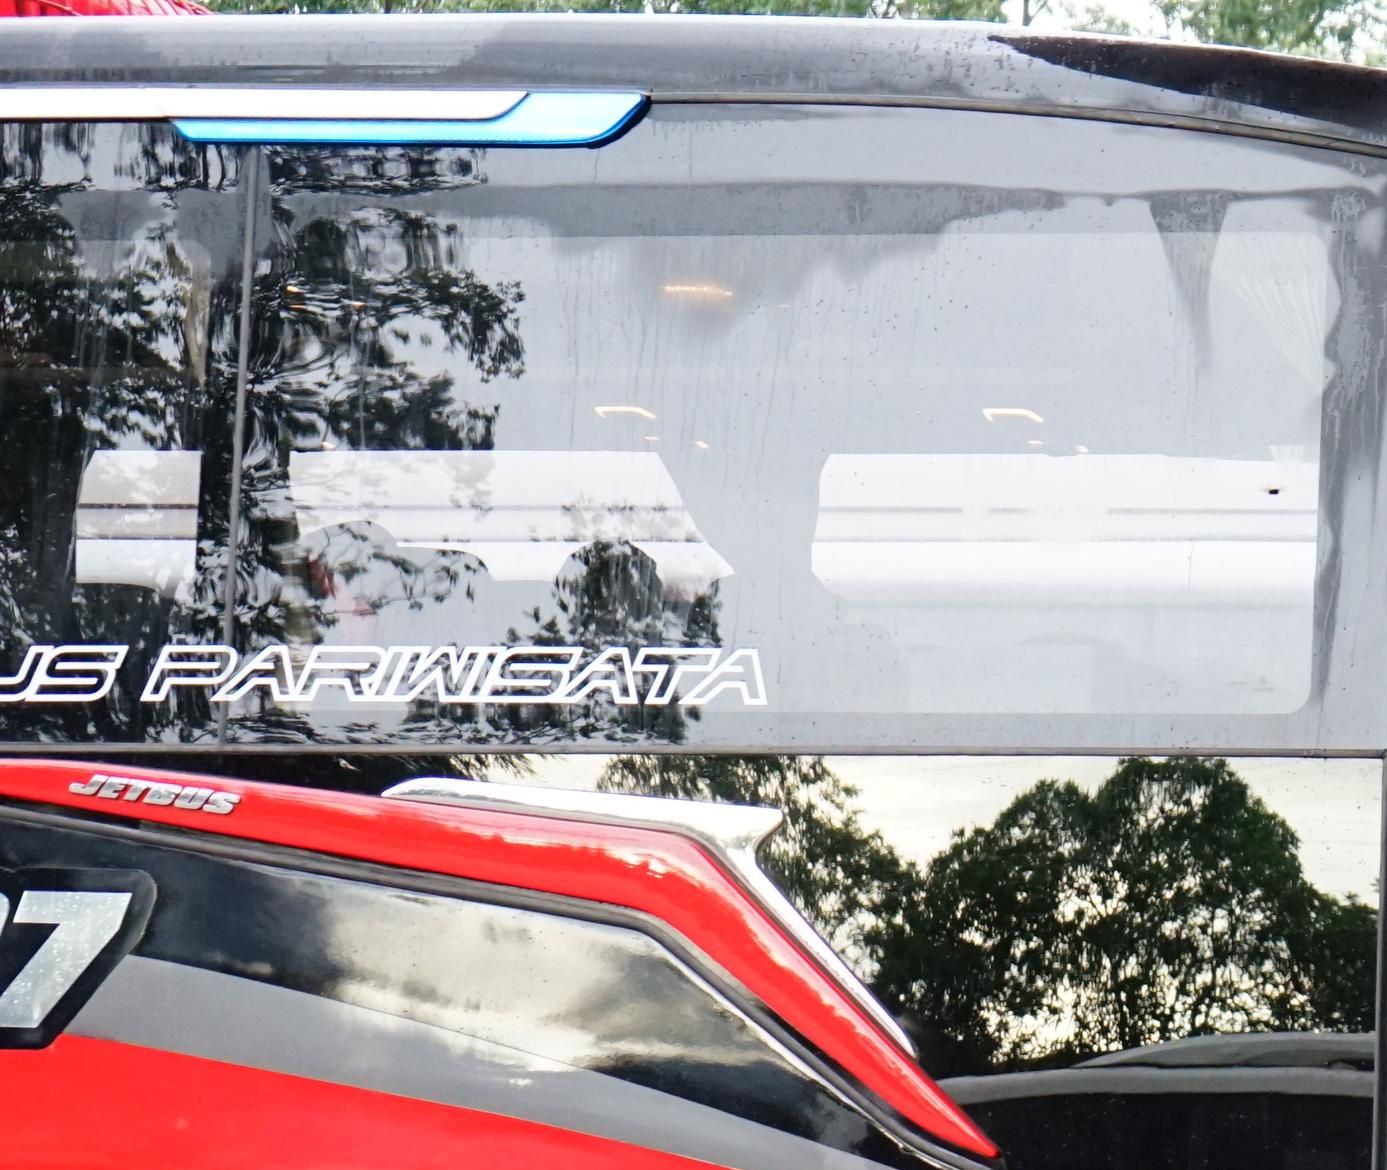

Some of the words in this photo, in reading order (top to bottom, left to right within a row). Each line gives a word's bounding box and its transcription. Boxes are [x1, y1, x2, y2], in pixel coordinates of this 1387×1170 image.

[140, 645, 768, 705] PARIWISATA
[68, 773, 241, 815] JETBUS
[0, 890, 133, 1029] 7
